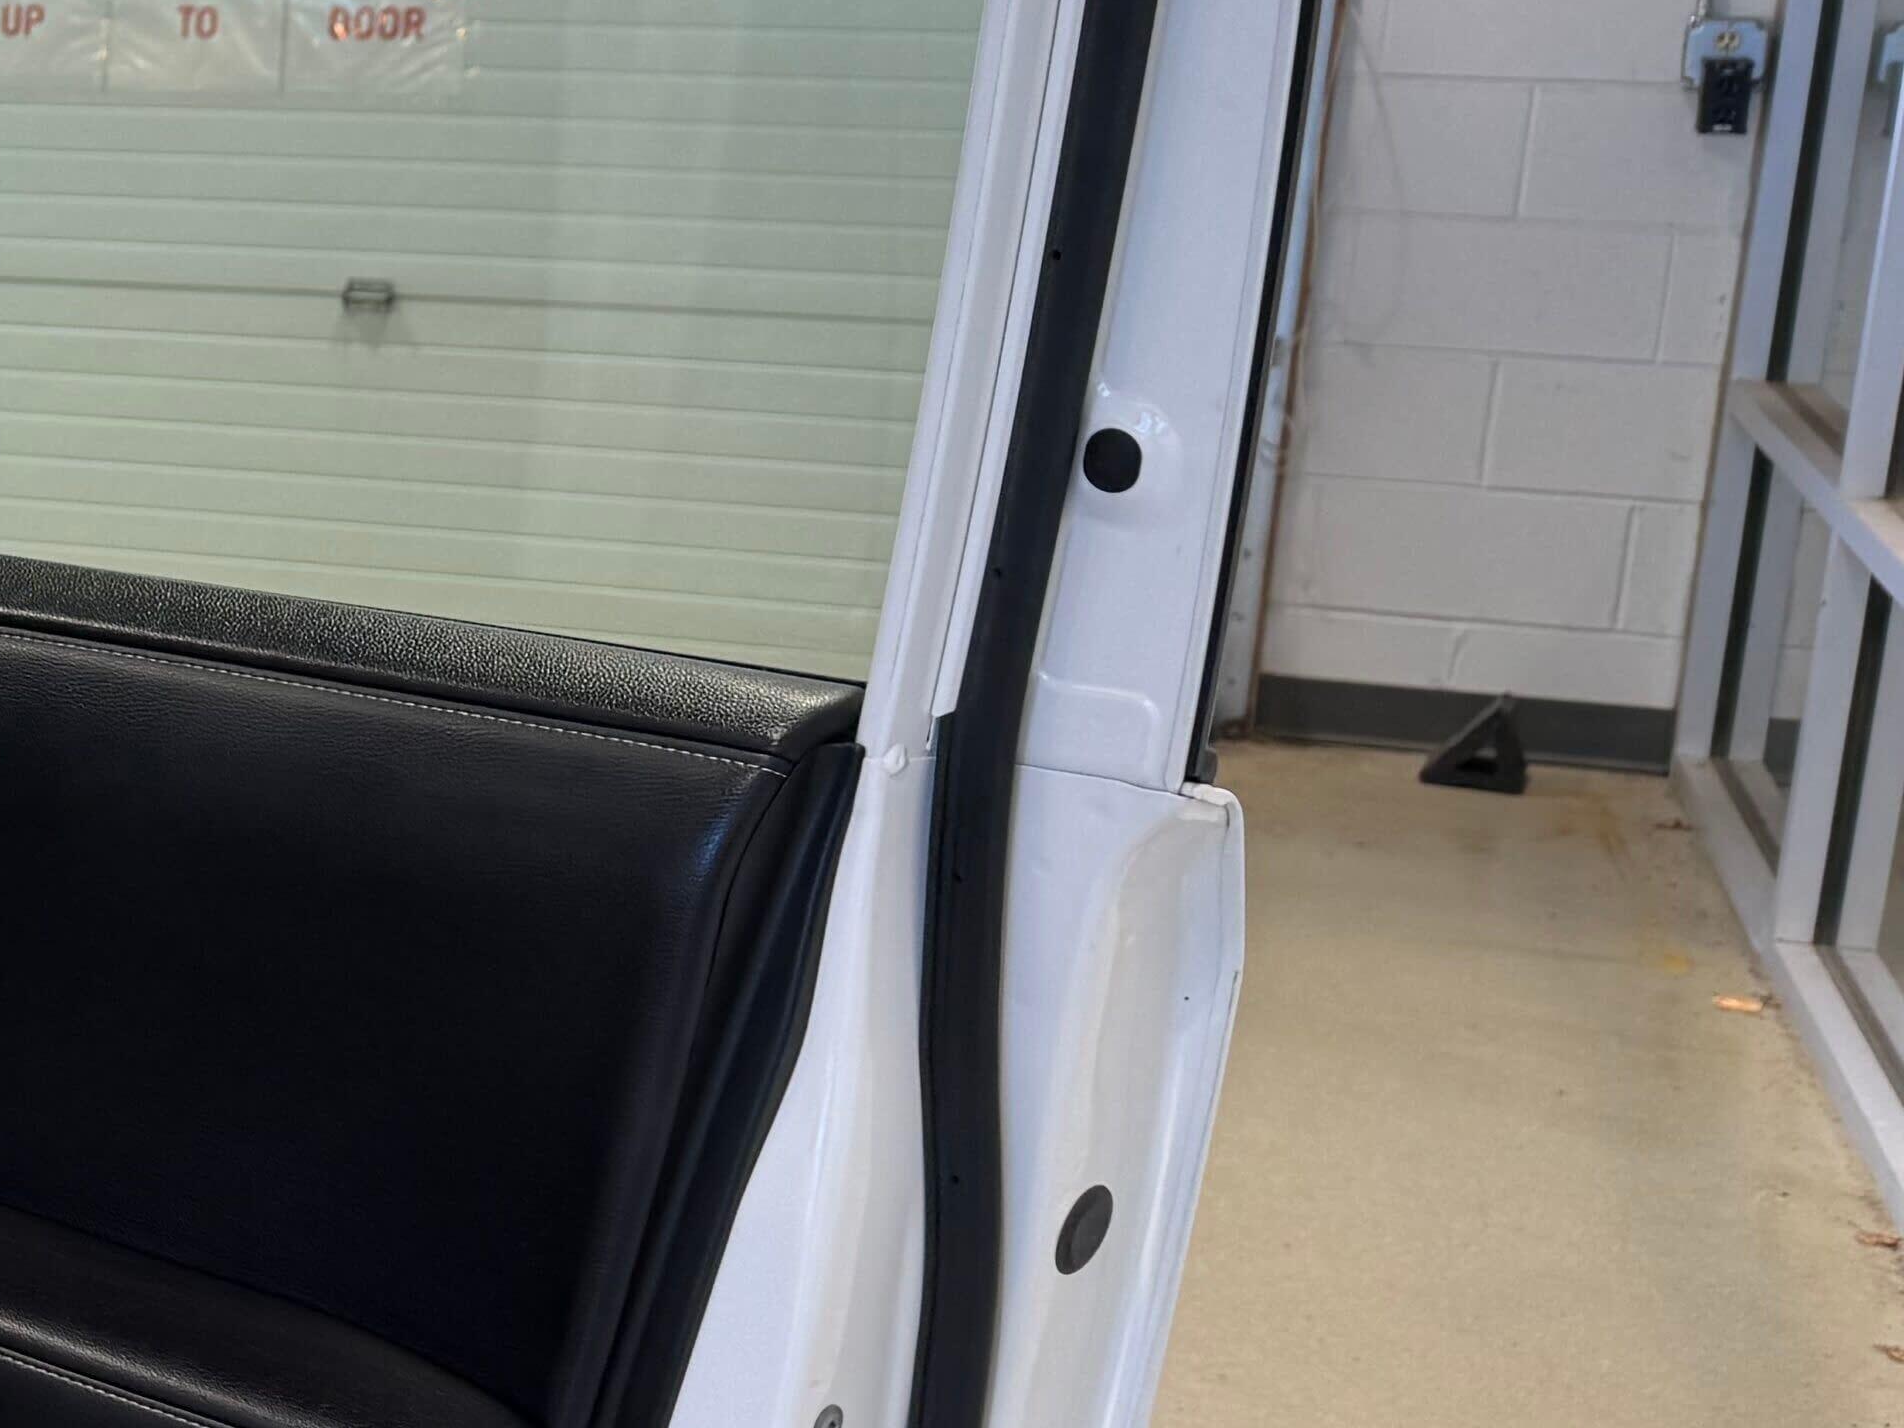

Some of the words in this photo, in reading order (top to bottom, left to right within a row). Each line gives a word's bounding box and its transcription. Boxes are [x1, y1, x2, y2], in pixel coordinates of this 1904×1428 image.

[0, 4, 45, 38] UP
[176, 4, 219, 40] TO
[326, 5, 427, 43] DOOR
